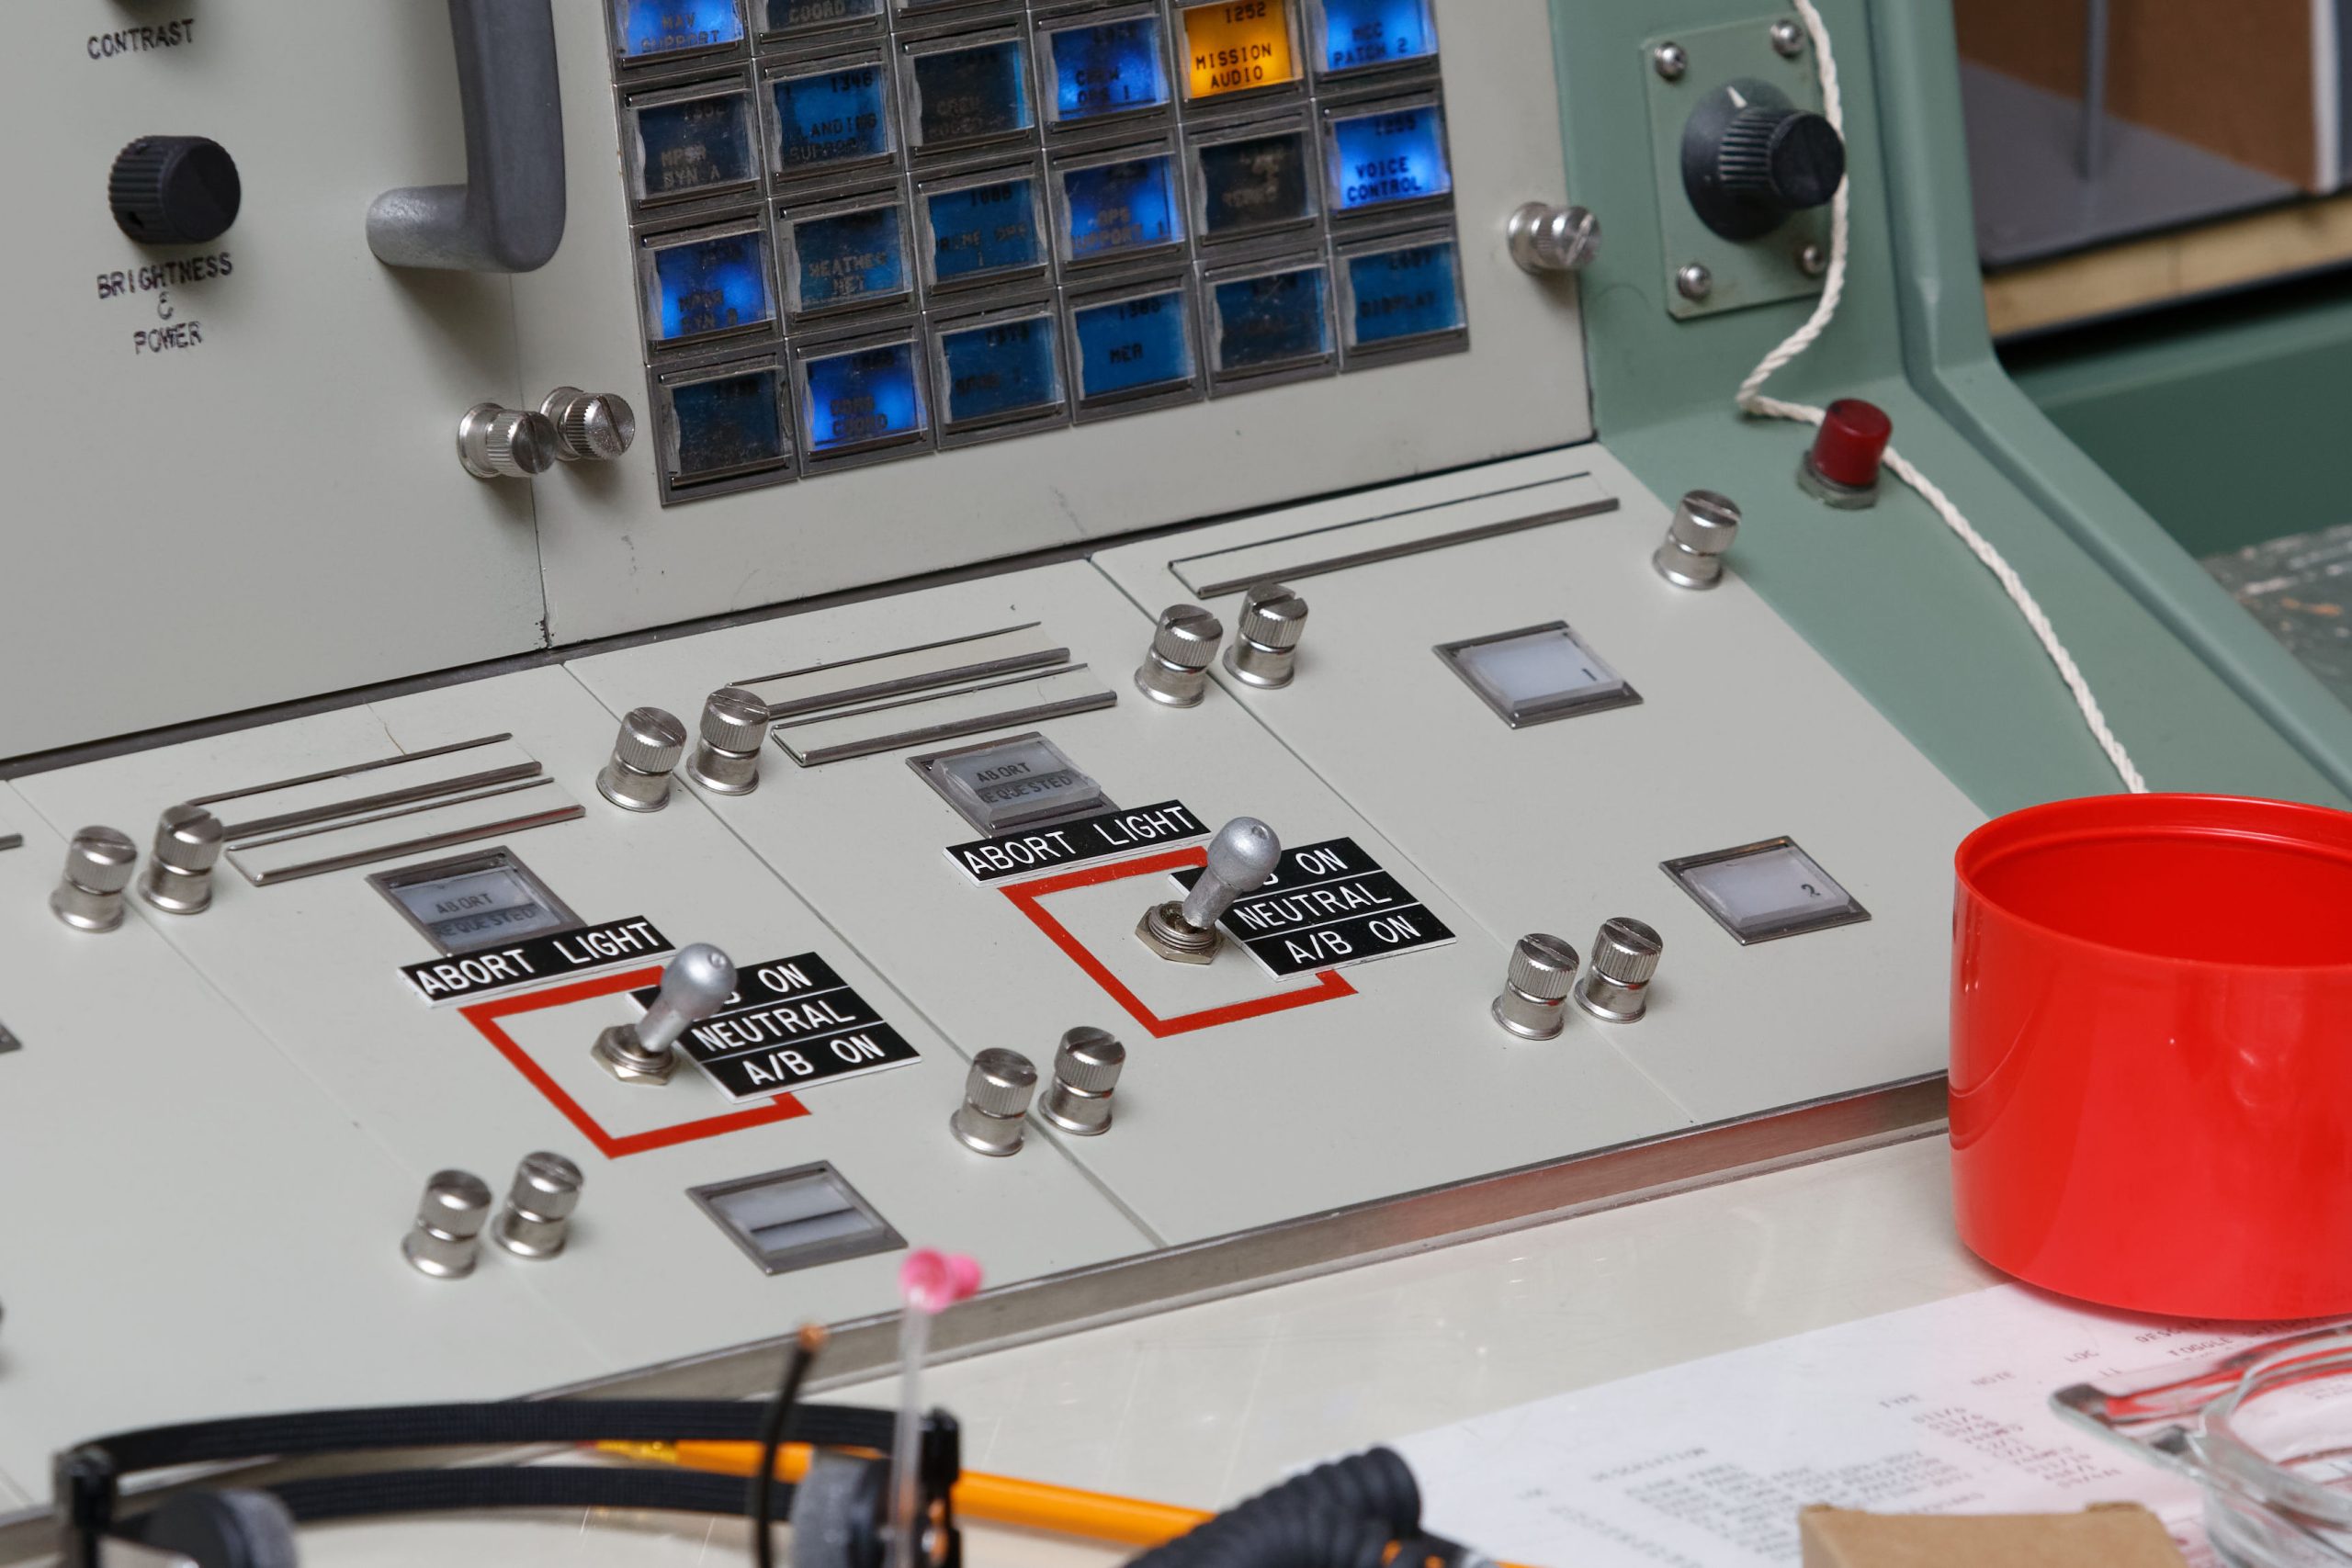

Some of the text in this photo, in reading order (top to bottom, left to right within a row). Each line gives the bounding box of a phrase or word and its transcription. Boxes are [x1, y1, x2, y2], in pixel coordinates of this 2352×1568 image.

[1225, 3, 1267, 24] 1252
[86, 18, 195, 60] CONTRAST
[641, 30, 719, 51] SUPPORT
[1397, 38, 1408, 53] 2
[1196, 43, 1272, 70] MISSION
[1210, 65, 1264, 89] AUDIO
[1356, 156, 1408, 177] VOICE
[1348, 175, 1422, 201] CONTROL
[936, 230, 981, 251] RIME
[96, 253, 233, 299] BRIGHTNESS
[133, 321, 202, 355] POWER
[1580, 667, 1598, 682] 1
[976, 761, 1032, 784] ABORT
[964, 806, 1194, 874] ABORT LIGHT
[1295, 847, 1349, 875] ON
[435, 892, 494, 915] ABORT
[1799, 883, 1821, 898] 2
[1232, 883, 1393, 931] NEUTRAL
[1284, 915, 1422, 964] A/B ON
[415, 921, 660, 996] ABORT LIGHT
[757, 963, 813, 993] ON
[690, 999, 856, 1053] NEUTRAL
[741, 1033, 886, 1086] A/B ON
[2064, 1349, 2100, 1363] LOC
[2168, 1337, 2233, 1357] TOGGLE
